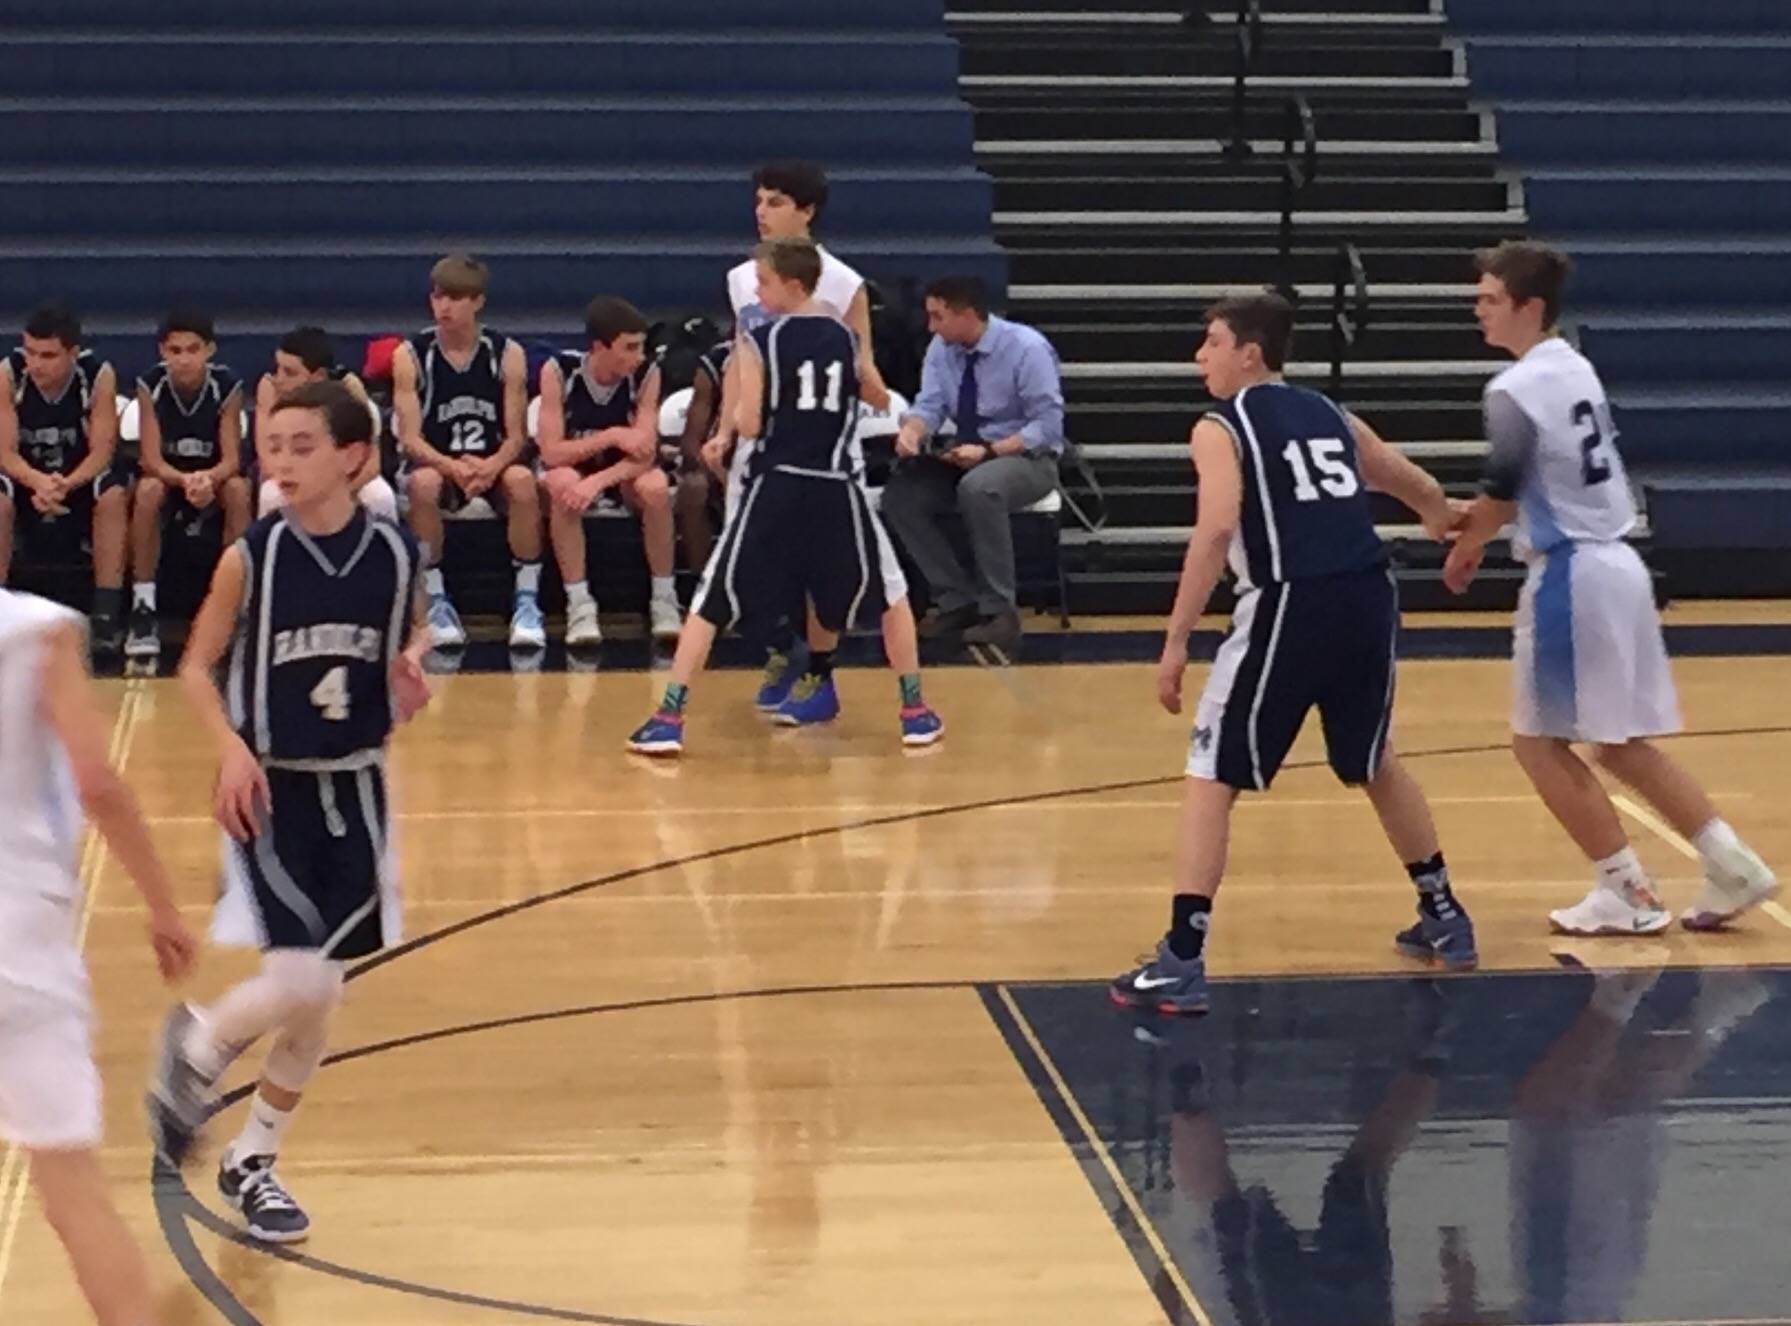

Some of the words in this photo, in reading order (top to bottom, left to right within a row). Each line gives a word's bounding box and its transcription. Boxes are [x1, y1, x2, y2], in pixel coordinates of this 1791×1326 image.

[797, 360, 842, 412] 11
[450, 420, 486, 451] 12
[1571, 399, 1618, 486] 2
[1282, 437, 1358, 501] 15
[309, 665, 351, 721] 4
